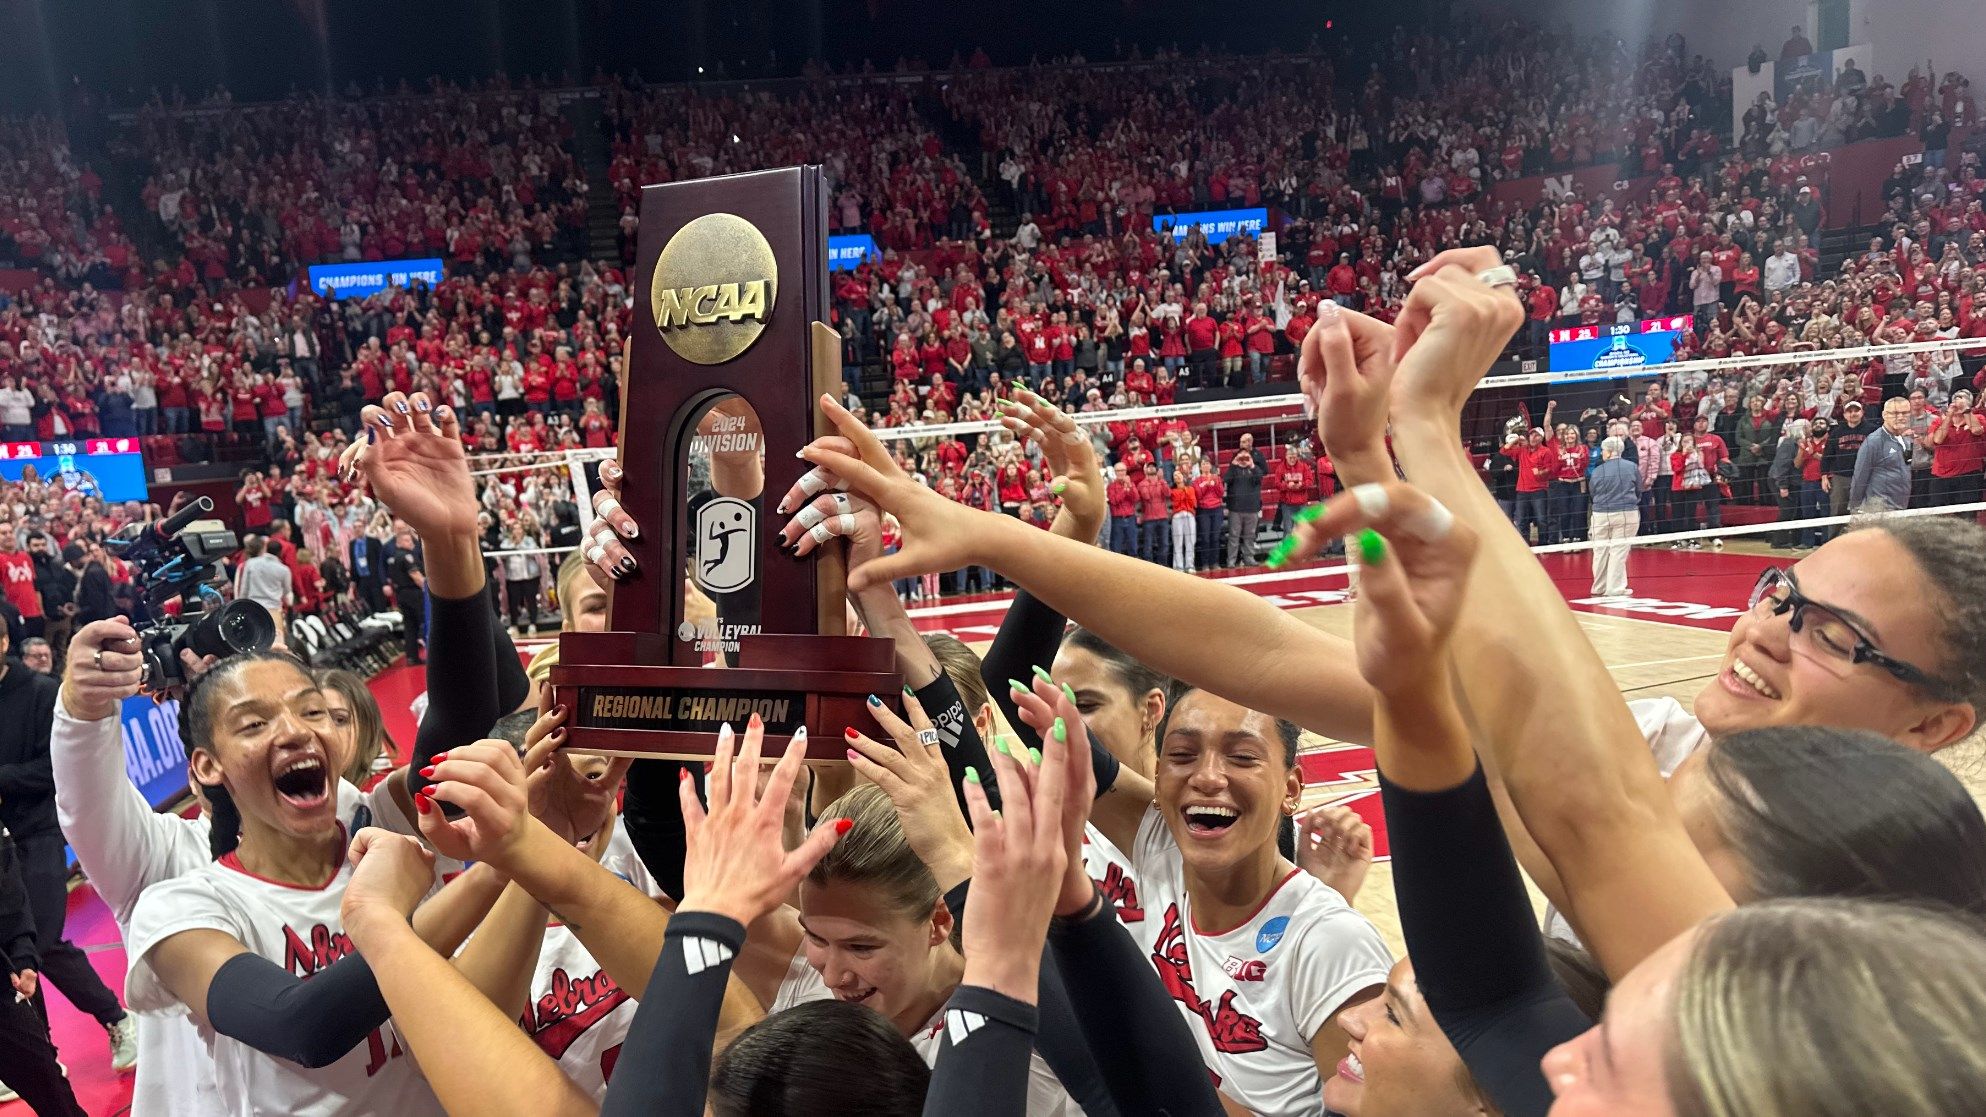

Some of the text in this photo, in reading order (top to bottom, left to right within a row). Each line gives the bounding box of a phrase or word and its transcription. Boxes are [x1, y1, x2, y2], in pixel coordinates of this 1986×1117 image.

[318, 273, 384, 290] CHAMPIONS
[658, 279, 768, 329] NCAA
[1610, 325, 1631, 335] 1:30
[1523, 362, 1536, 371] EXIT
[1102, 374, 1114, 382] A4
[711, 416, 746, 433] 2024
[690, 433, 758, 453] DIVISION
[694, 641, 741, 653] CHAMPION
[593, 694, 790, 723] REGIONAL CHAMPION
[121, 699, 187, 788] AA.OR
